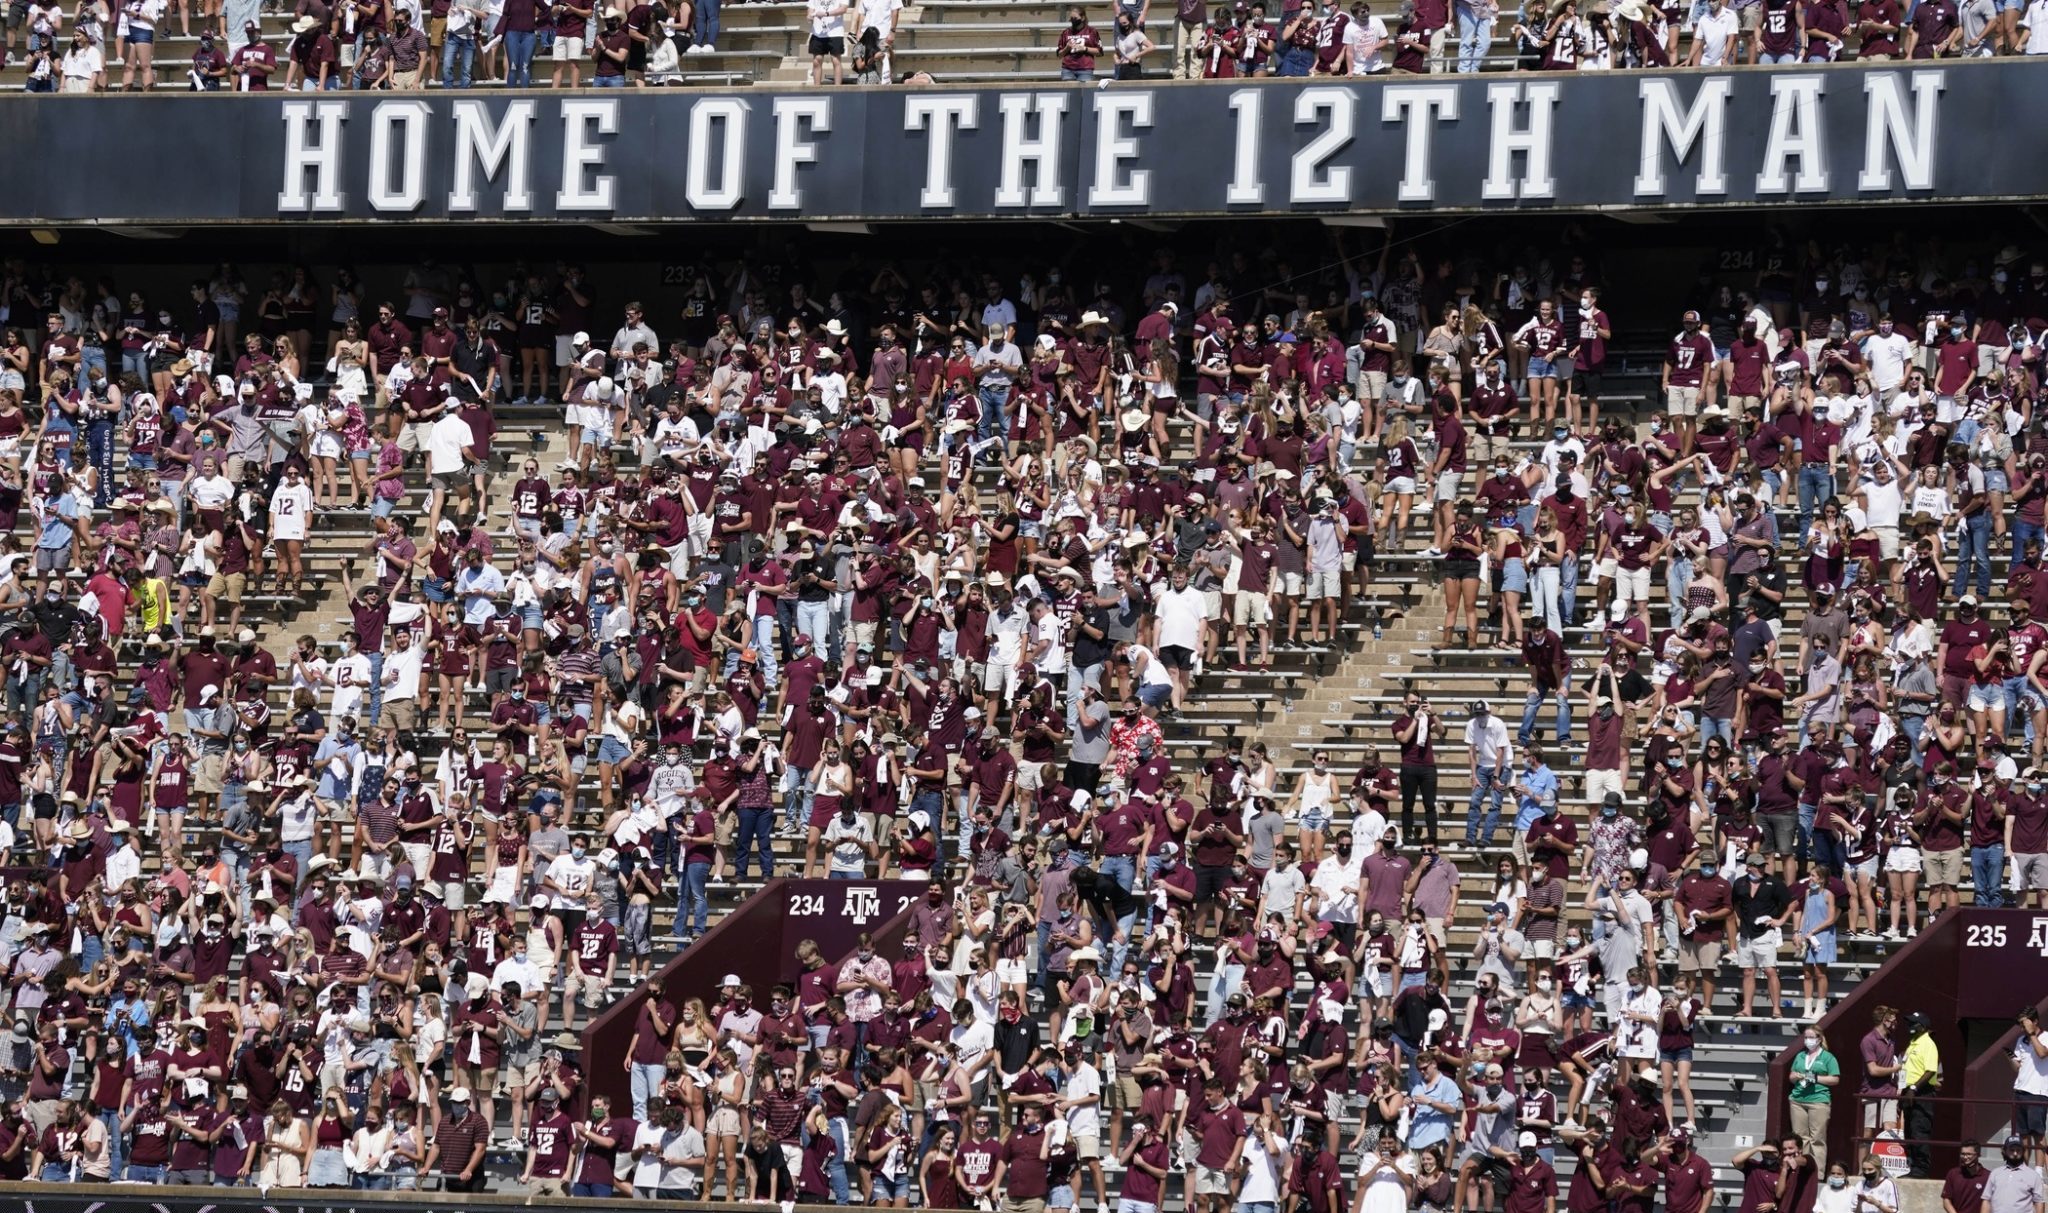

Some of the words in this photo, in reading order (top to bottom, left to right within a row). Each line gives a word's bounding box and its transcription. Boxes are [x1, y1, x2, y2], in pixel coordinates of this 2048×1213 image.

[1769, 15, 1786, 33] 12
[1553, 38, 1574, 63] 12
[278, 98, 620, 212] HOME
[685, 96, 833, 210] OF
[904, 89, 1157, 208] THE
[1226, 80, 1561, 204] 12TH
[1633, 69, 1947, 196] MAN
[1719, 251, 1754, 269] 234
[526, 305, 543, 325] 12
[1535, 333, 1552, 350] 12
[789, 348, 801, 363] 12
[1677, 351, 1695, 369] 17
[138, 430, 155, 445] 12
[1122, 451, 1138, 466] 12
[1388, 448, 1402, 467] 12
[949, 461, 962, 479] 12
[278, 498, 294, 515] 12
[520, 494, 537, 514] 12
[447, 640, 455, 651] 12
[338, 666, 352, 685] 12
[929, 712, 945, 730] 12
[275, 763, 295, 787] 12
[453, 767, 467, 792] 12
[656, 770, 686, 779] AGGIES
[438, 833, 455, 853] 12
[566, 874, 582, 890] 12
[789, 894, 825, 916] 234
[475, 931, 492, 949] 12
[1966, 924, 2007, 947] 235
[581, 940, 600, 959] 12
[1568, 964, 1582, 982] 12
[286, 1069, 304, 1091] 15
[1522, 1106, 1540, 1120] 12
[56, 1131, 78, 1153] 12
[536, 1134, 555, 1154] 12
